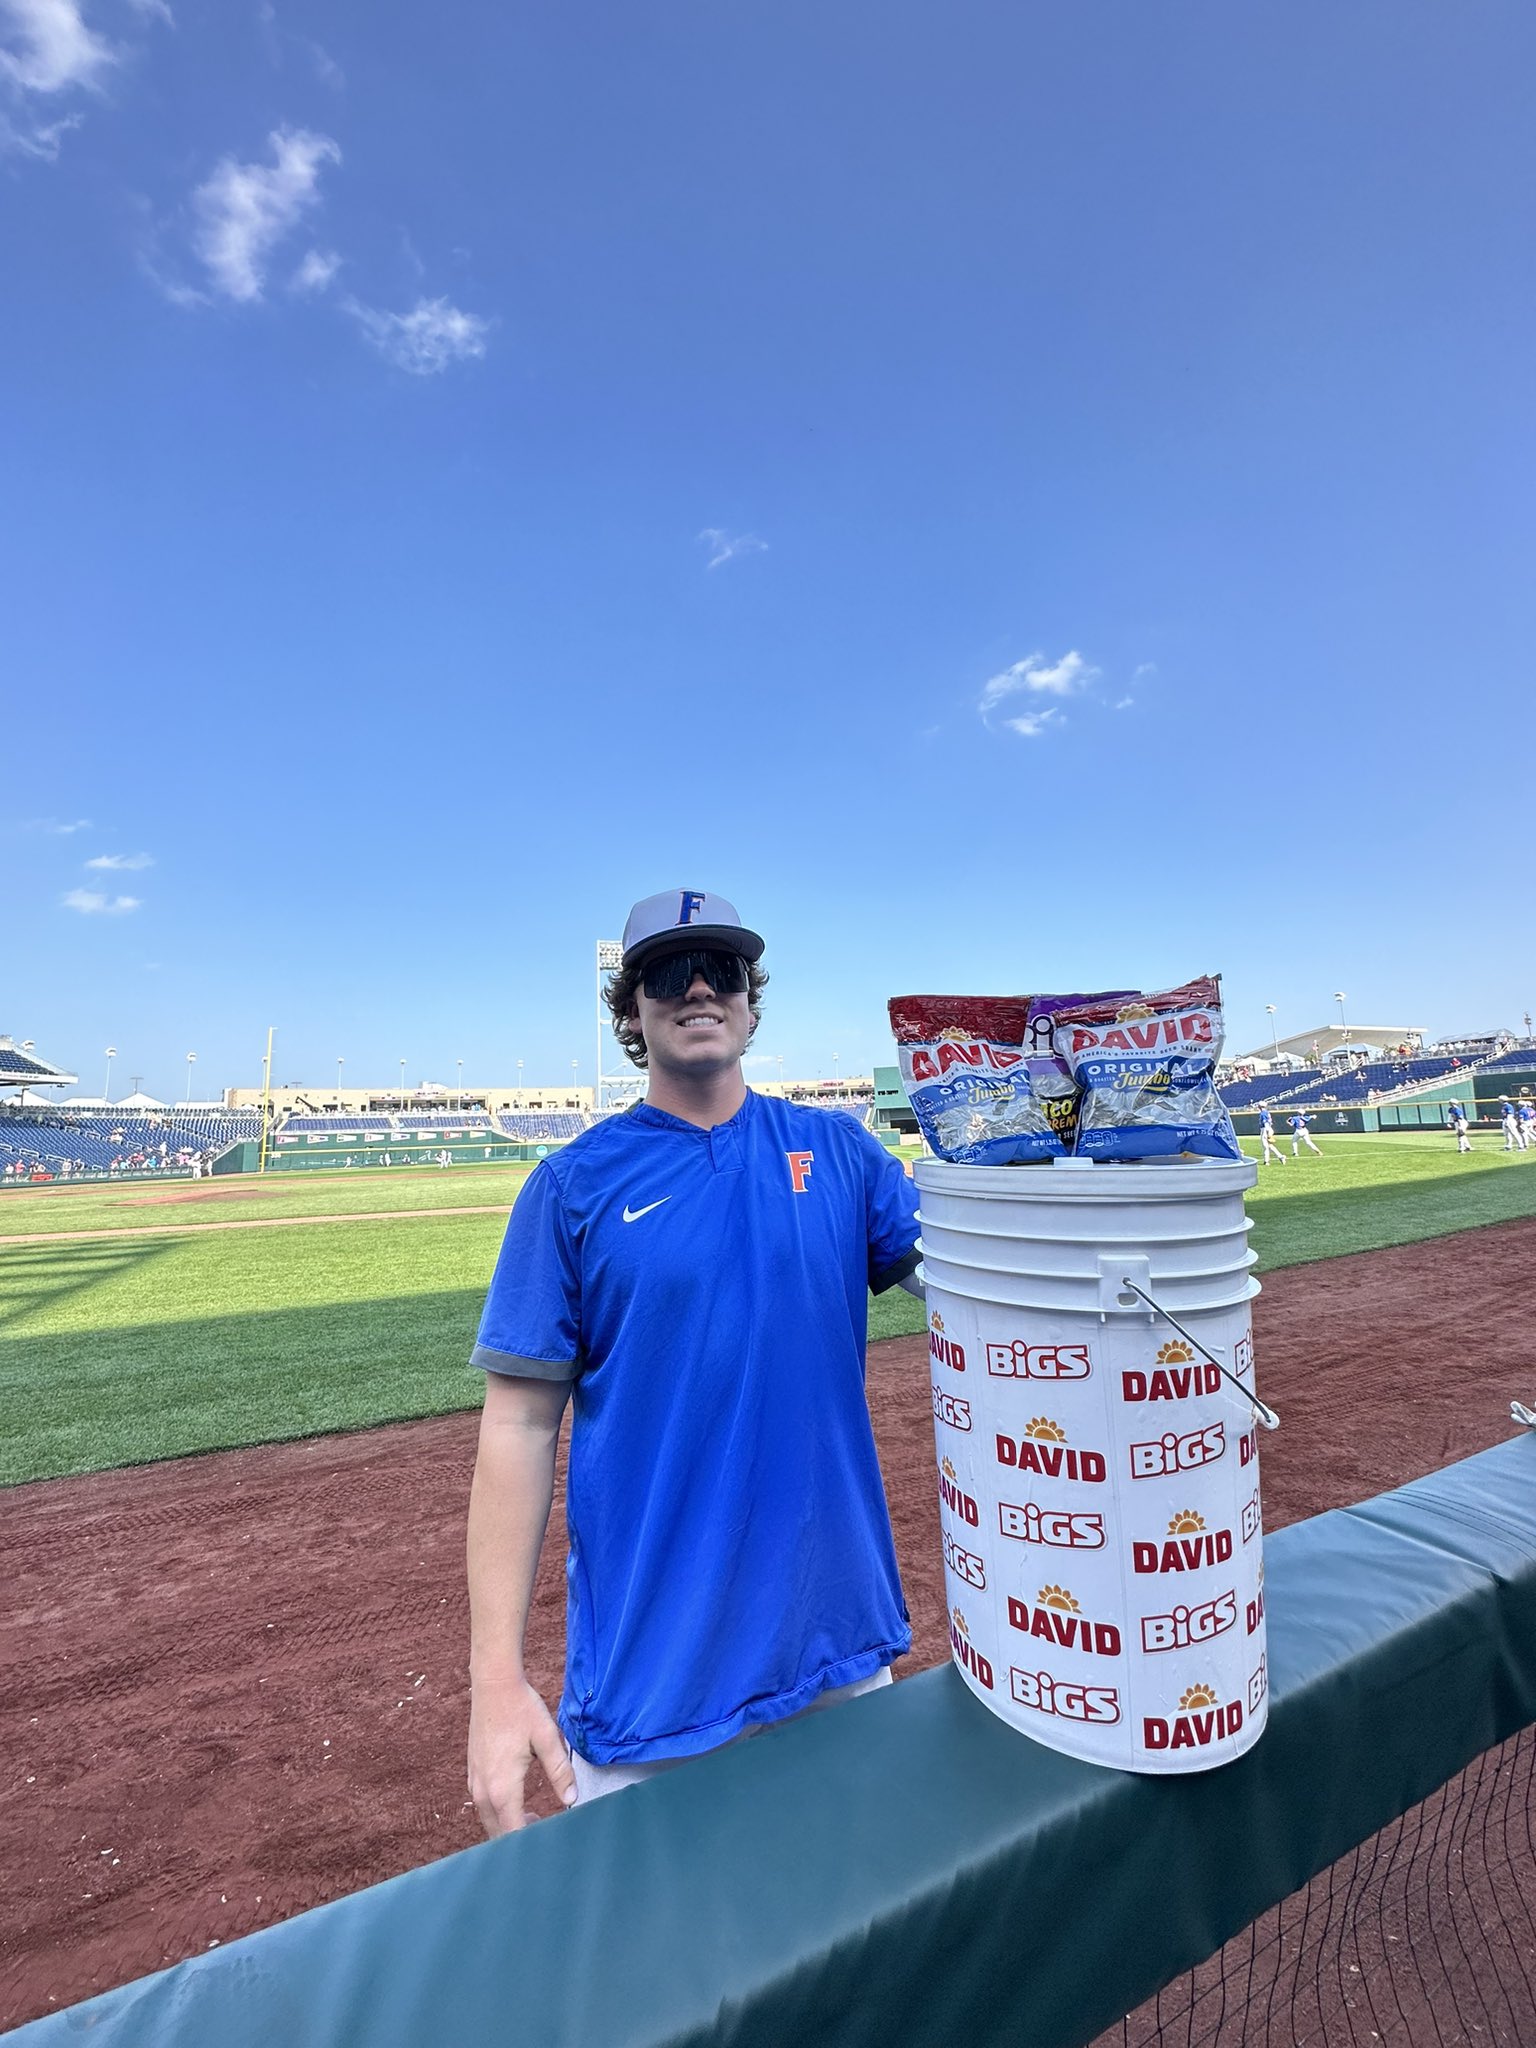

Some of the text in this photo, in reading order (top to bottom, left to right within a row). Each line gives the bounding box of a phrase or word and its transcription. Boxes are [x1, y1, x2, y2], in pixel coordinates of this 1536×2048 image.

[676, 891, 705, 926] F
[1072, 1013, 1213, 1054] DAVID
[912, 1043, 1023, 1082] DAVID
[1087, 1062, 1202, 1076] ORIGINAL
[1113, 1071, 1171, 1090] Jumbo
[939, 1074, 1031, 1096] ORIGINAL
[967, 1083, 1016, 1105] Jumbo
[786, 1150, 815, 1193] F
[930, 1330, 966, 1372] AVID
[1122, 1363, 1222, 1402] DAVID
[996, 1434, 1107, 1482] DAVID
[939, 1474, 979, 1528] AVID
[1133, 1529, 1233, 1573] DAVID
[1007, 1595, 1121, 1656] DAVID
[951, 1622, 994, 1691] AVID
[1143, 1699, 1243, 1750] DAVID
